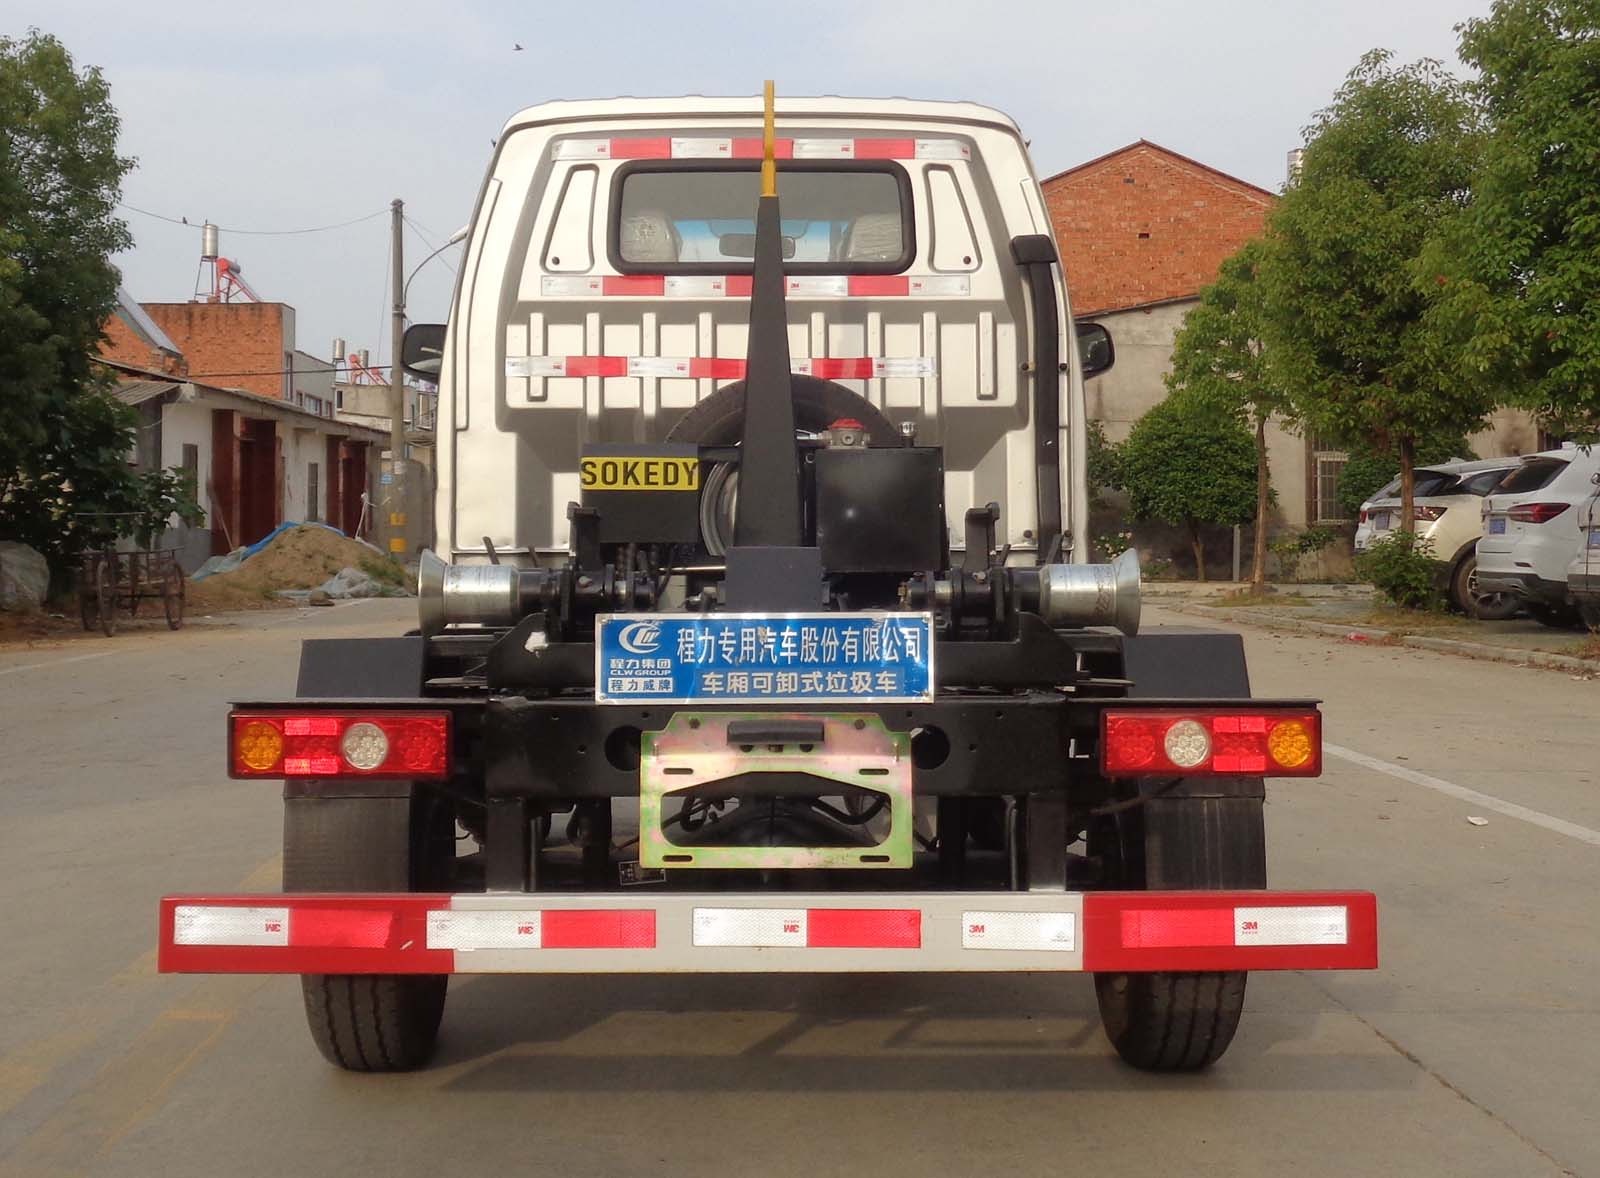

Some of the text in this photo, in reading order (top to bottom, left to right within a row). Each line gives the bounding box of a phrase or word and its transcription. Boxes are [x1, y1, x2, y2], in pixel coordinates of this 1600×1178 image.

[580, 461, 698, 486] SOKEDY
[677, 625, 921, 664] 程力专用汽车股份有限公司
[610, 659, 671, 669] 程力集团
[611, 679, 671, 691] 程力威牌
[702, 671, 897, 694] 车厢可卸式垃圾车
[969, 925, 985, 933] 3M
[1242, 921, 1258, 930] 3M
